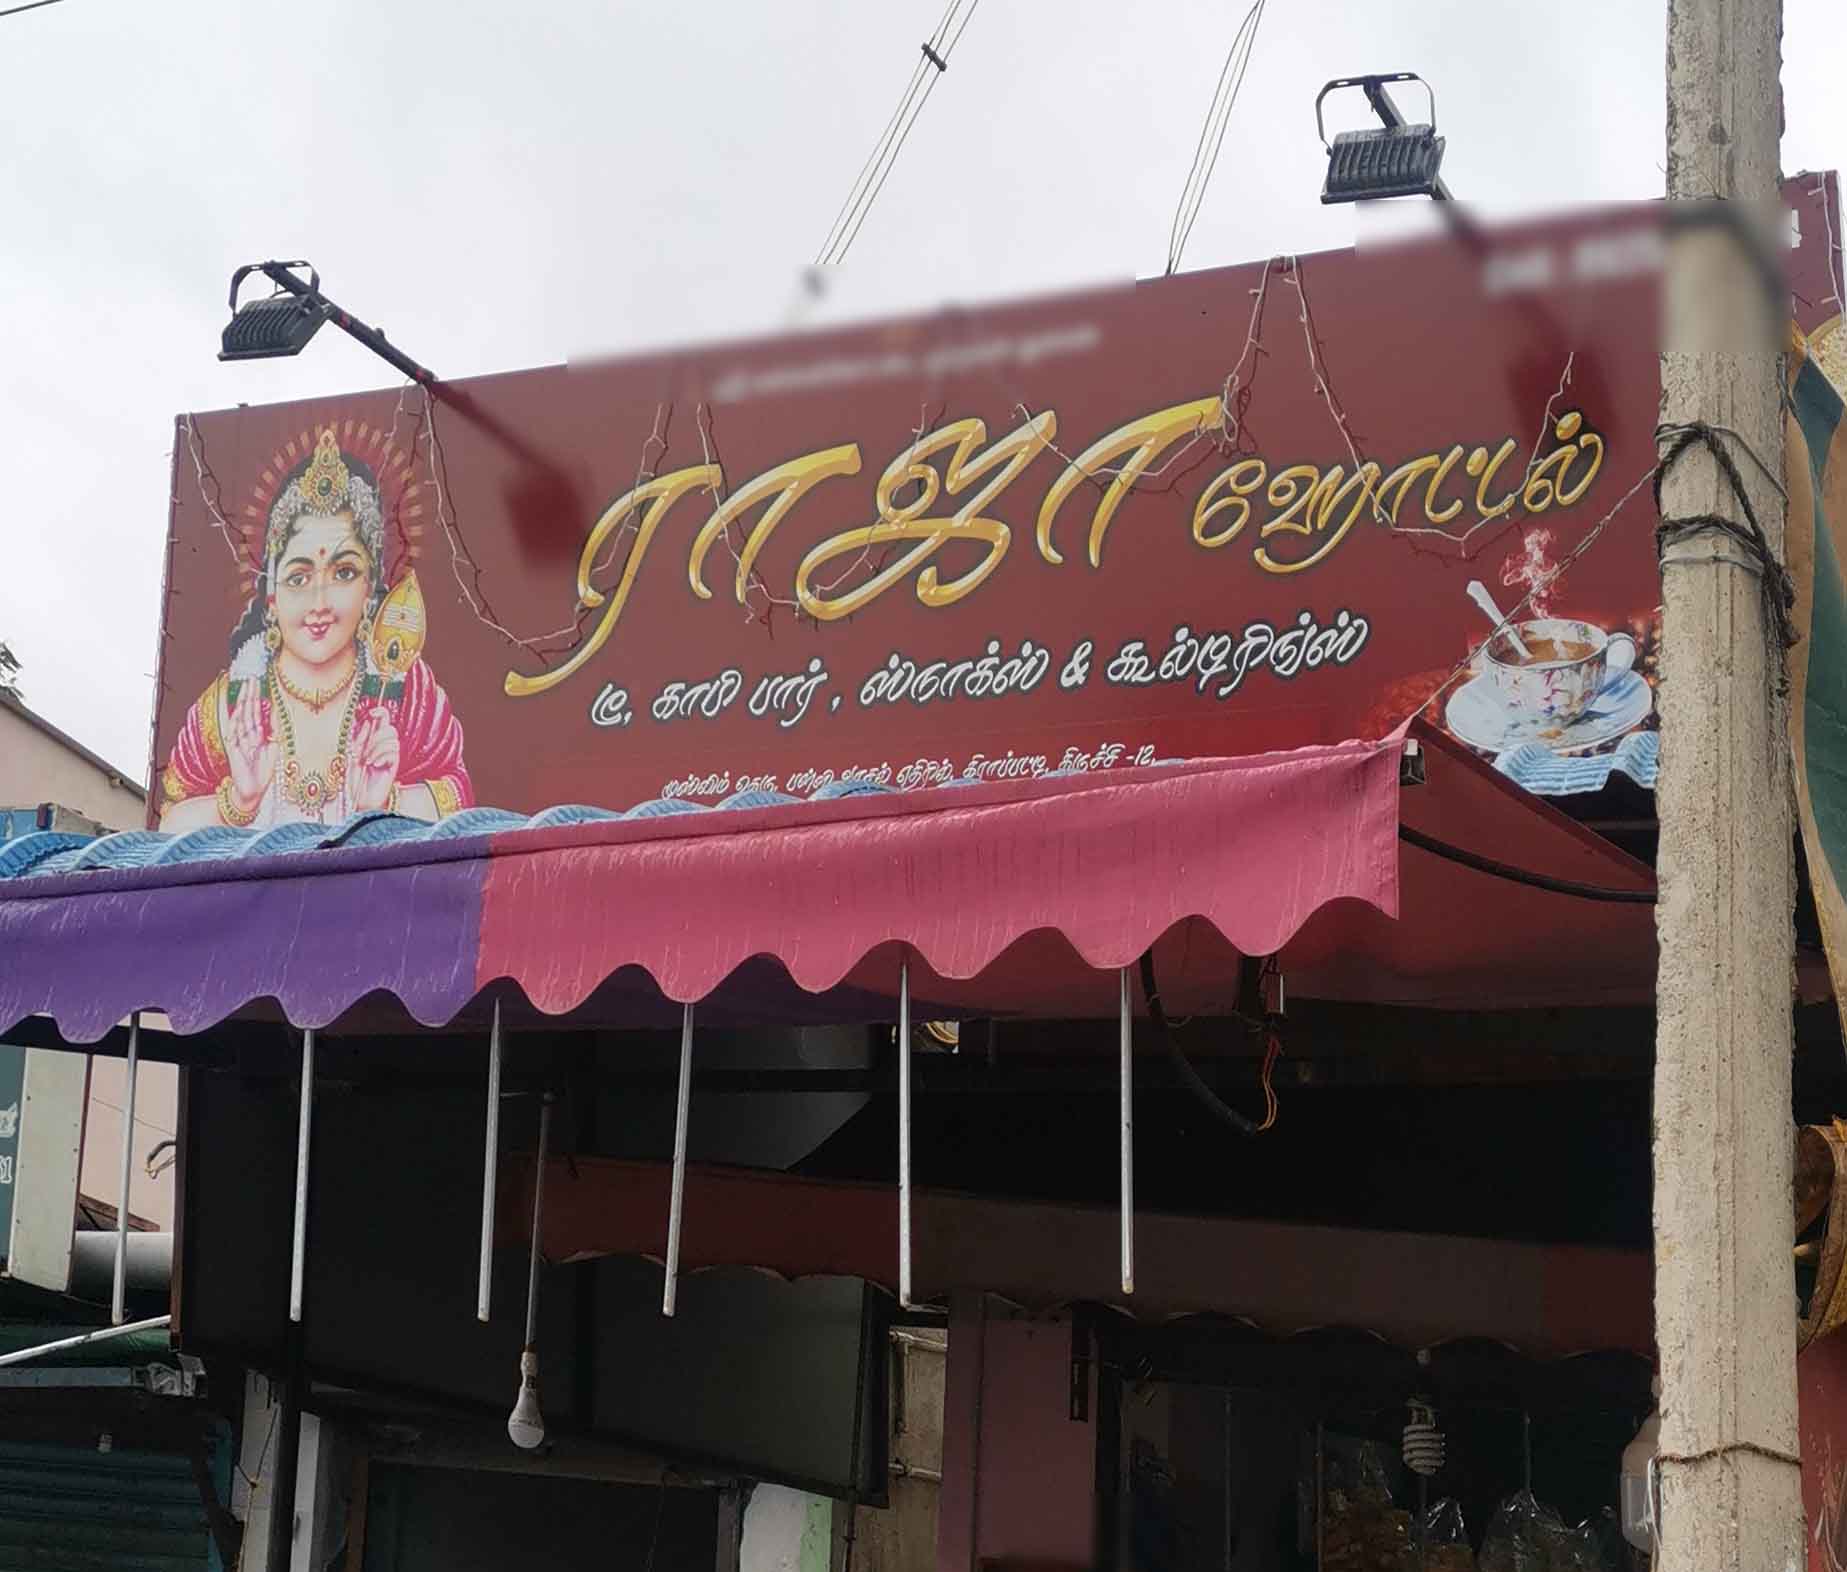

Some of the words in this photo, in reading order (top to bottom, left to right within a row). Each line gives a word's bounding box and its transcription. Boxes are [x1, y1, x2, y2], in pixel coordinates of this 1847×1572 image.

[504, 396, 1223, 697] ராஜா
[1193, 411, 1604, 573] ஹோட்டல்
[652, 669, 742, 720] காபி
[1060, 641, 1092, 687] &
